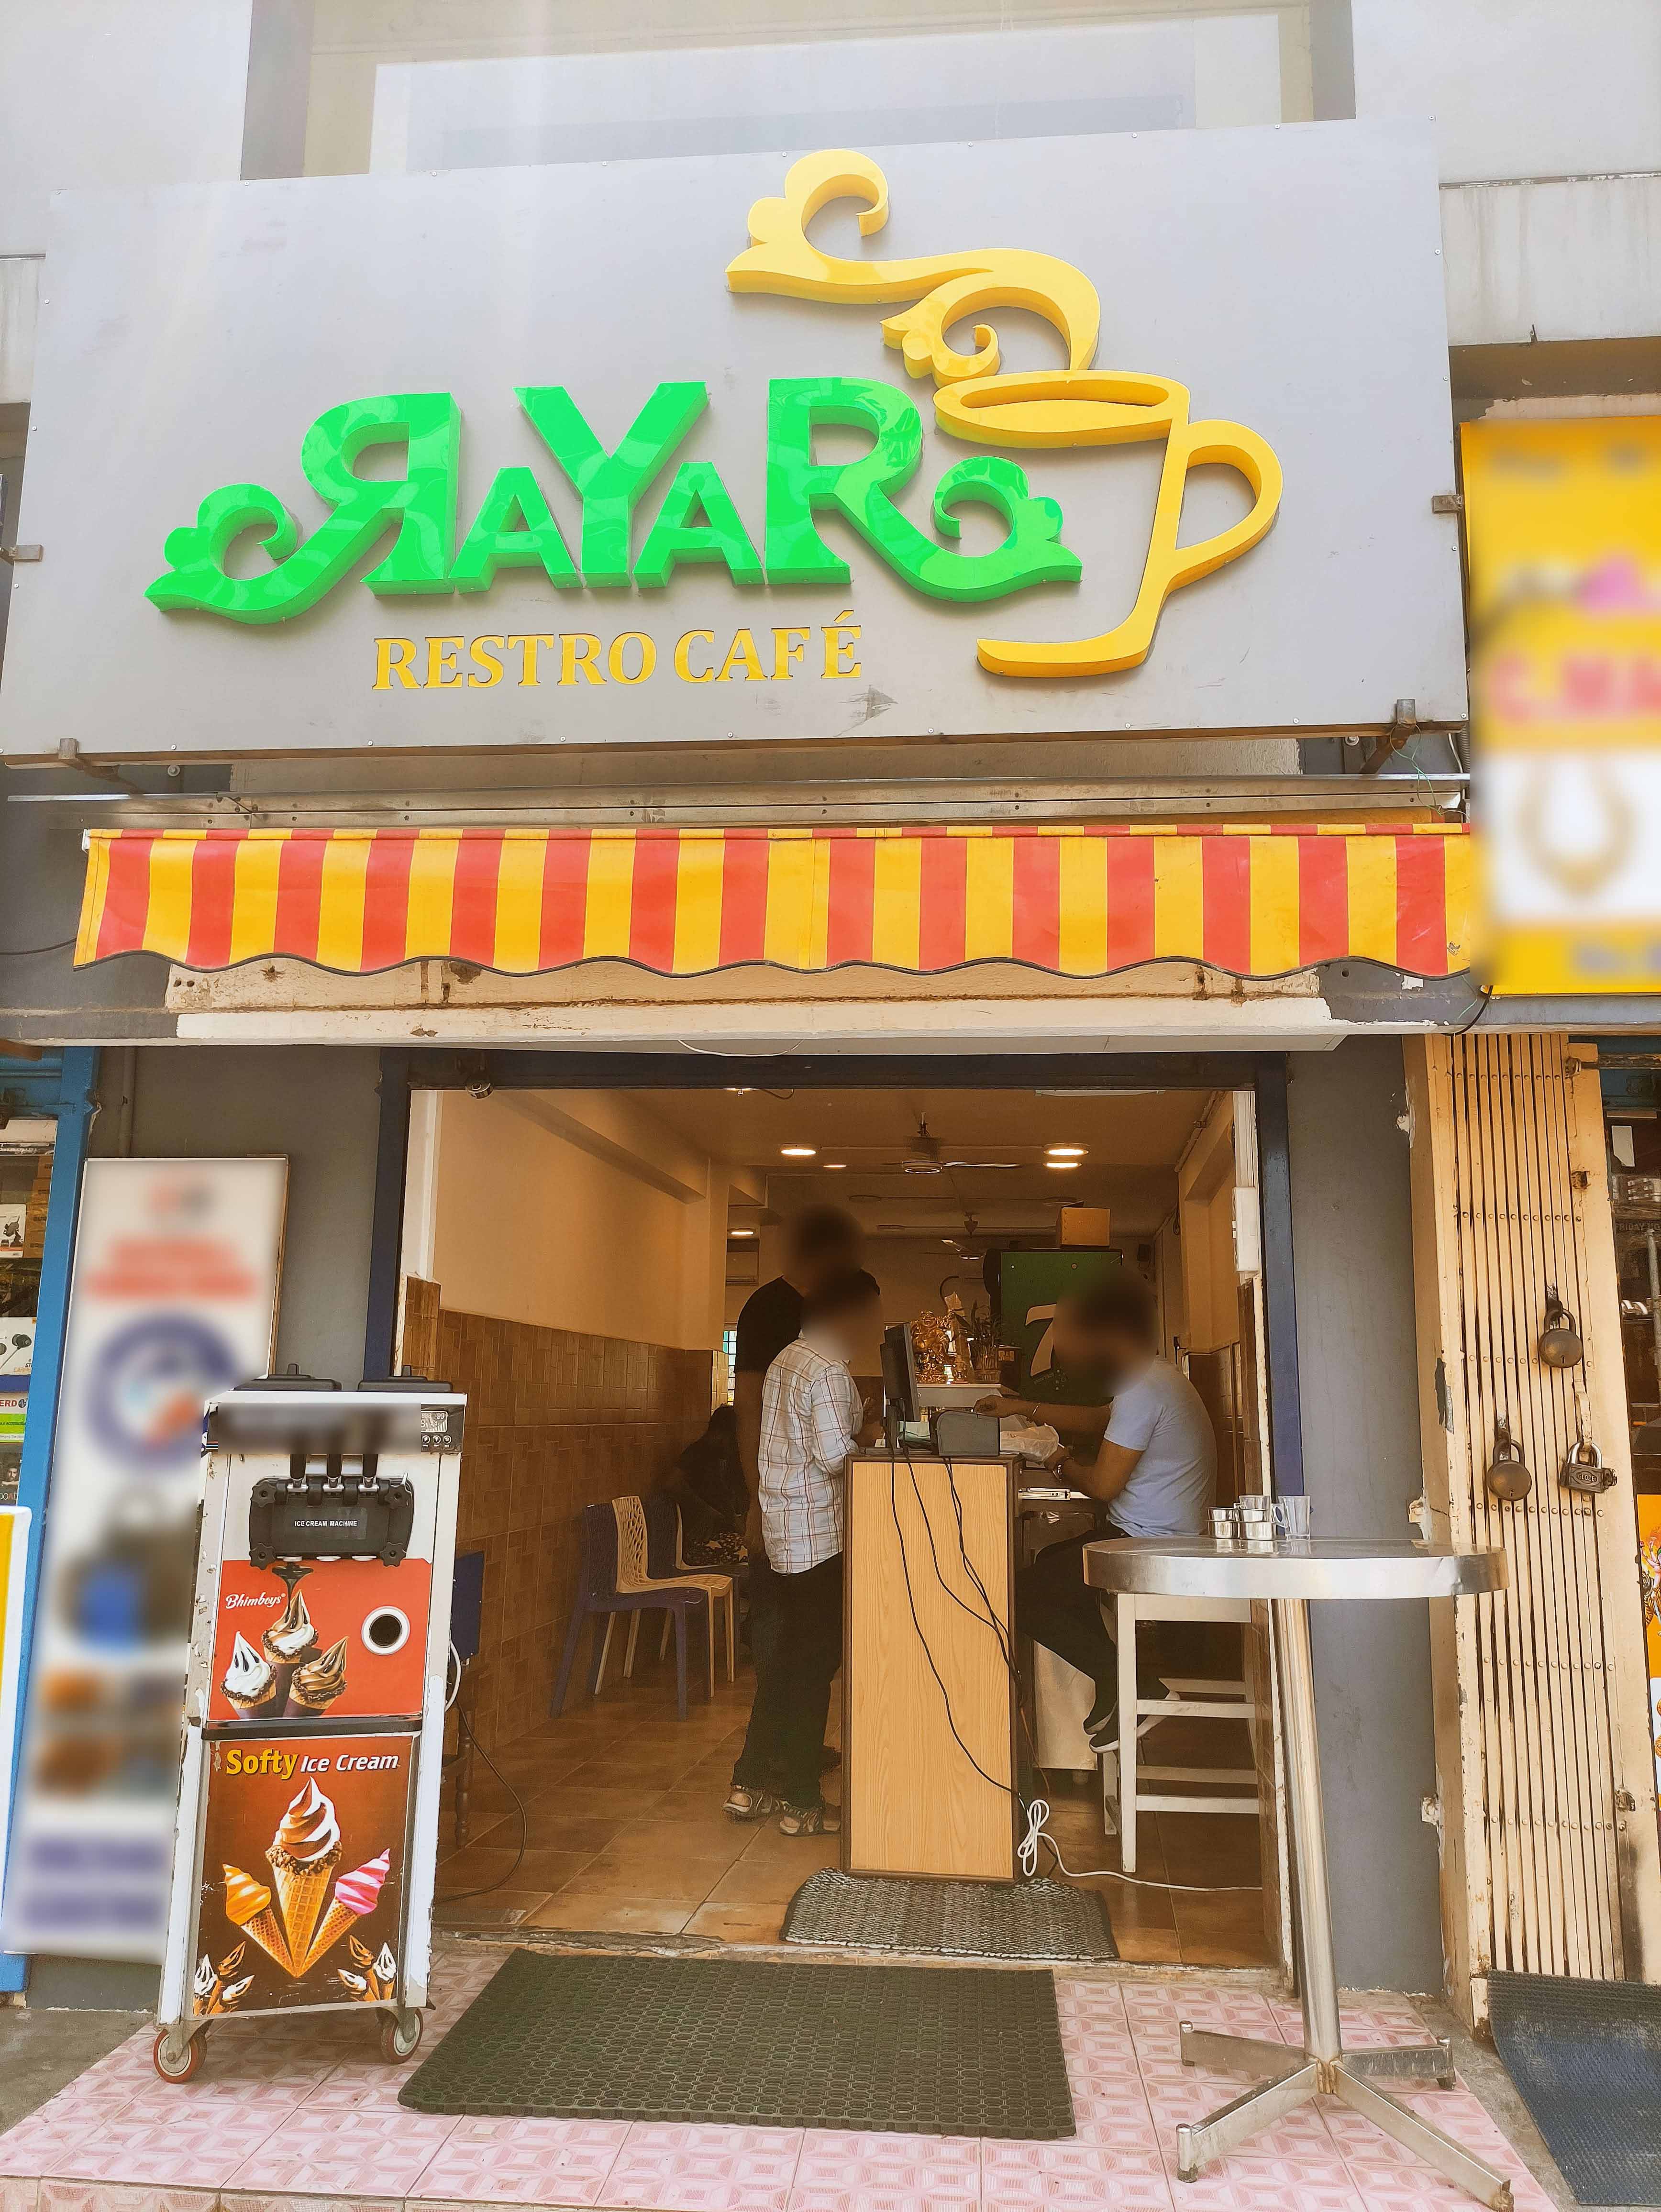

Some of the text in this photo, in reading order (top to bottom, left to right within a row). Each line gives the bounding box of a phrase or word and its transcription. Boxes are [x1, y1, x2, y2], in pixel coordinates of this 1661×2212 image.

[372, 609, 862, 690] RESTRO CAFÉ
[1578, 1473, 1596, 1482] GLOBE
[225, 1592, 282, 1609] Bhimboys
[226, 1748, 399, 1780] Softy Ice Cream
